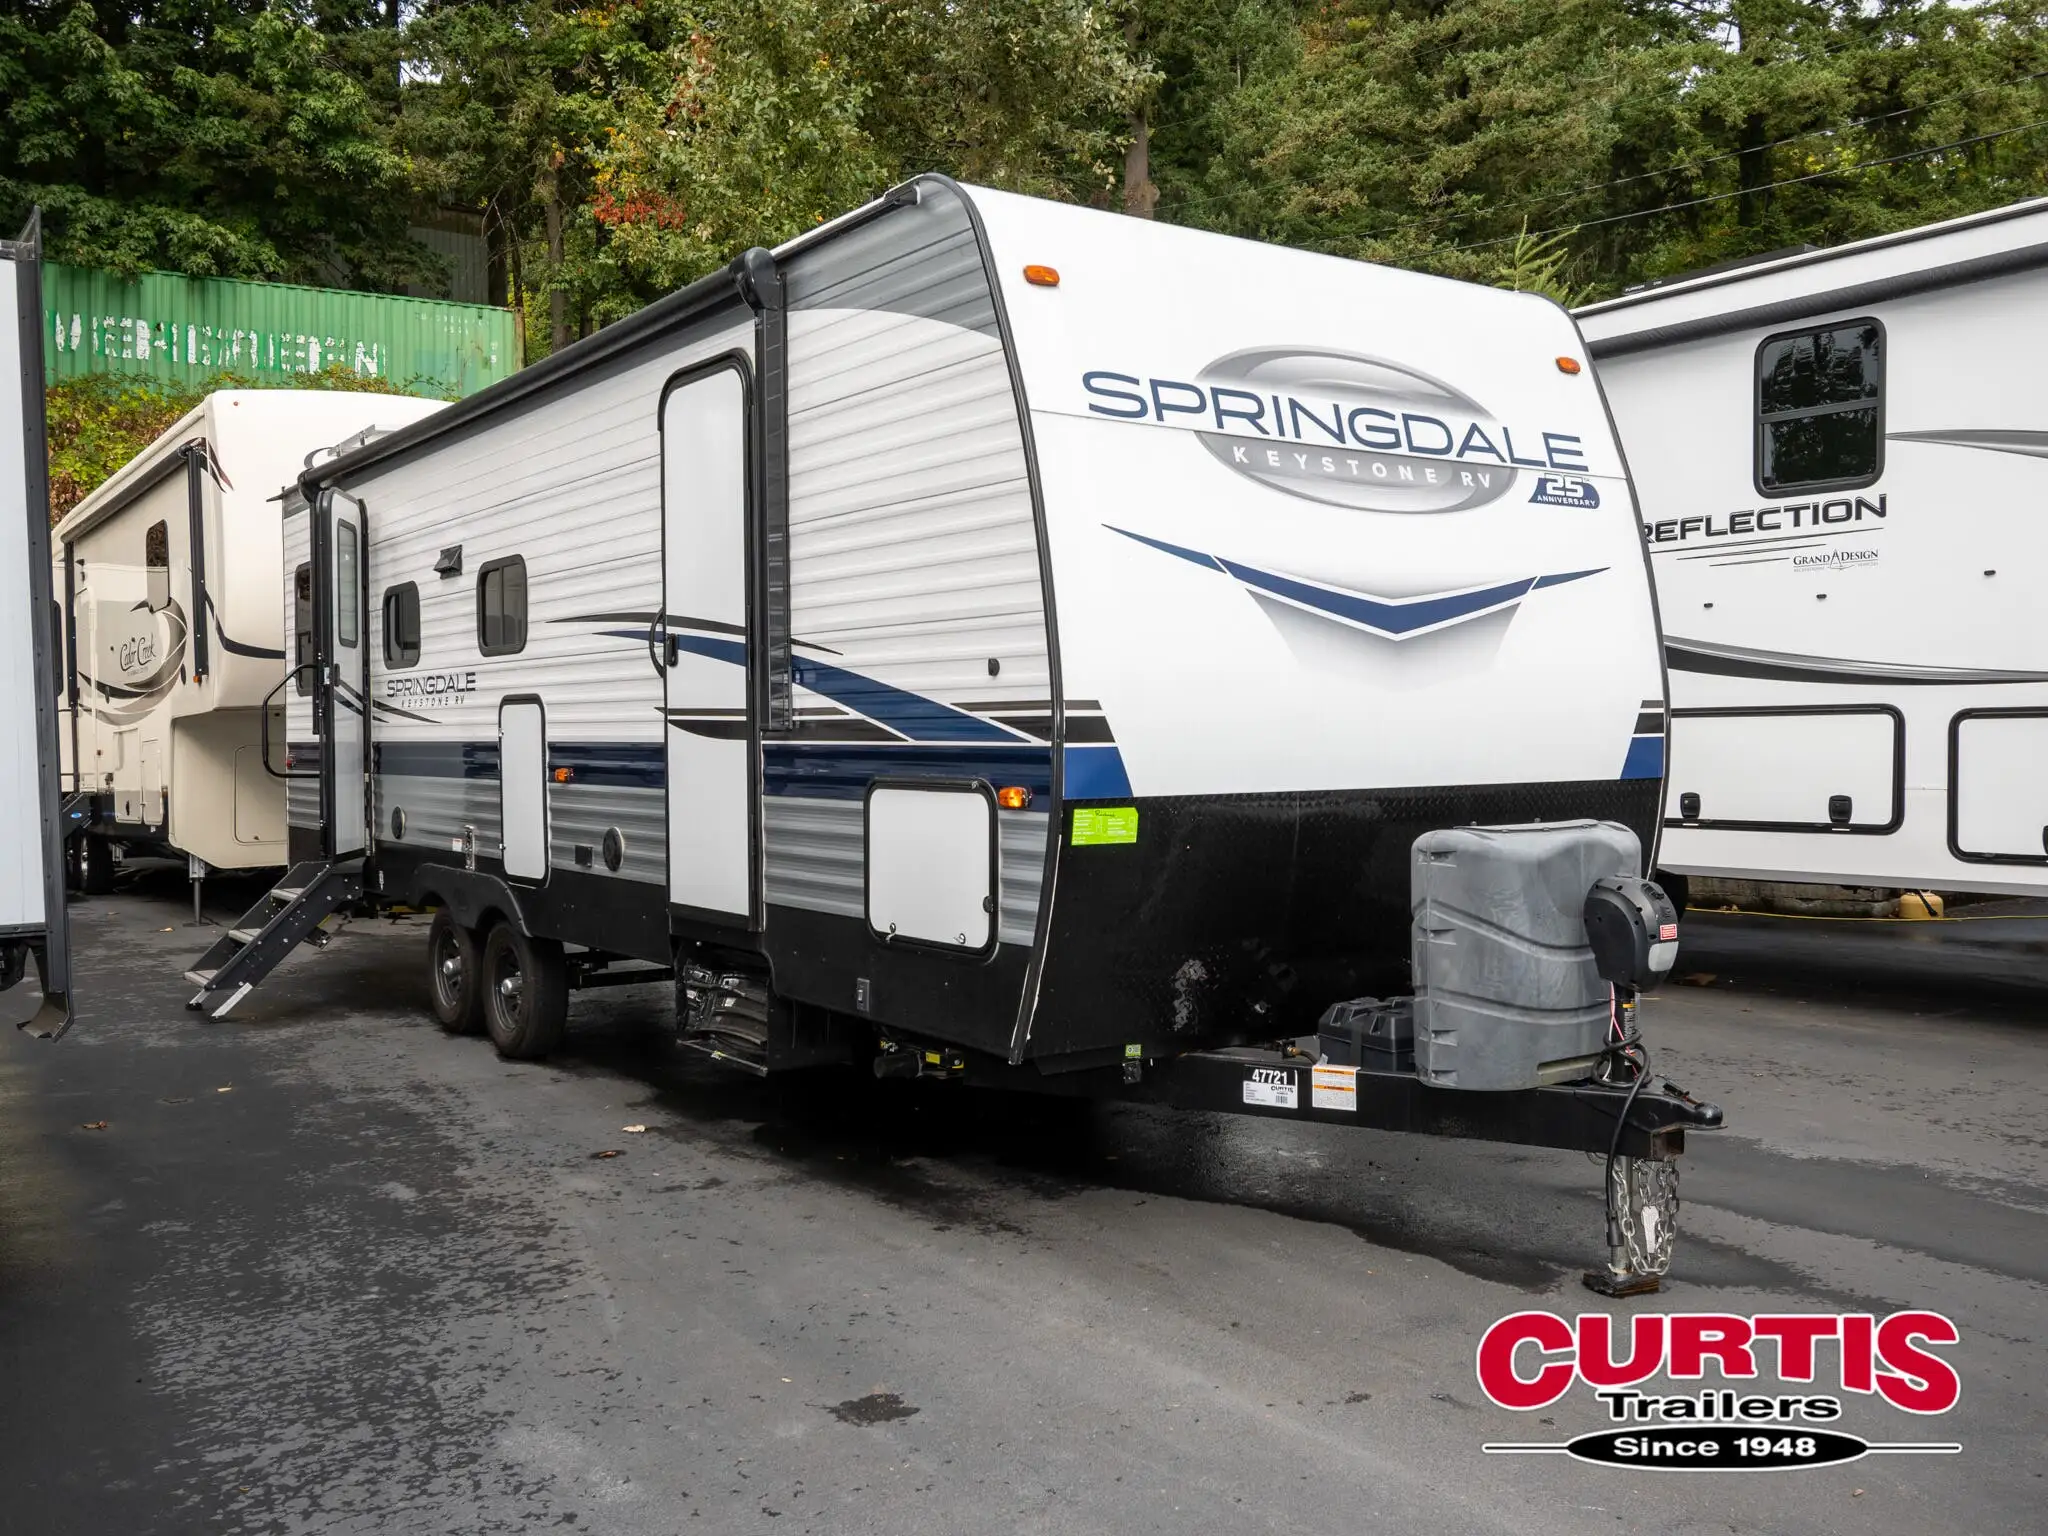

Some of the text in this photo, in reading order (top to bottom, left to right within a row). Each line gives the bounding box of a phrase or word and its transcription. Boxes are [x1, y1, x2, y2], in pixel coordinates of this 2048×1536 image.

[1082, 371, 1589, 473] SPRINGDALE
[1233, 446, 1491, 488] KEYSTONE RV
[1544, 473, 1584, 498] 25
[1537, 494, 1596, 507] ANNIVERSARY
[1793, 548, 1879, 566] GRAND DESIGN
[387, 672, 476, 698] SPRINGDALE
[1252, 1069, 1288, 1085] 47721
